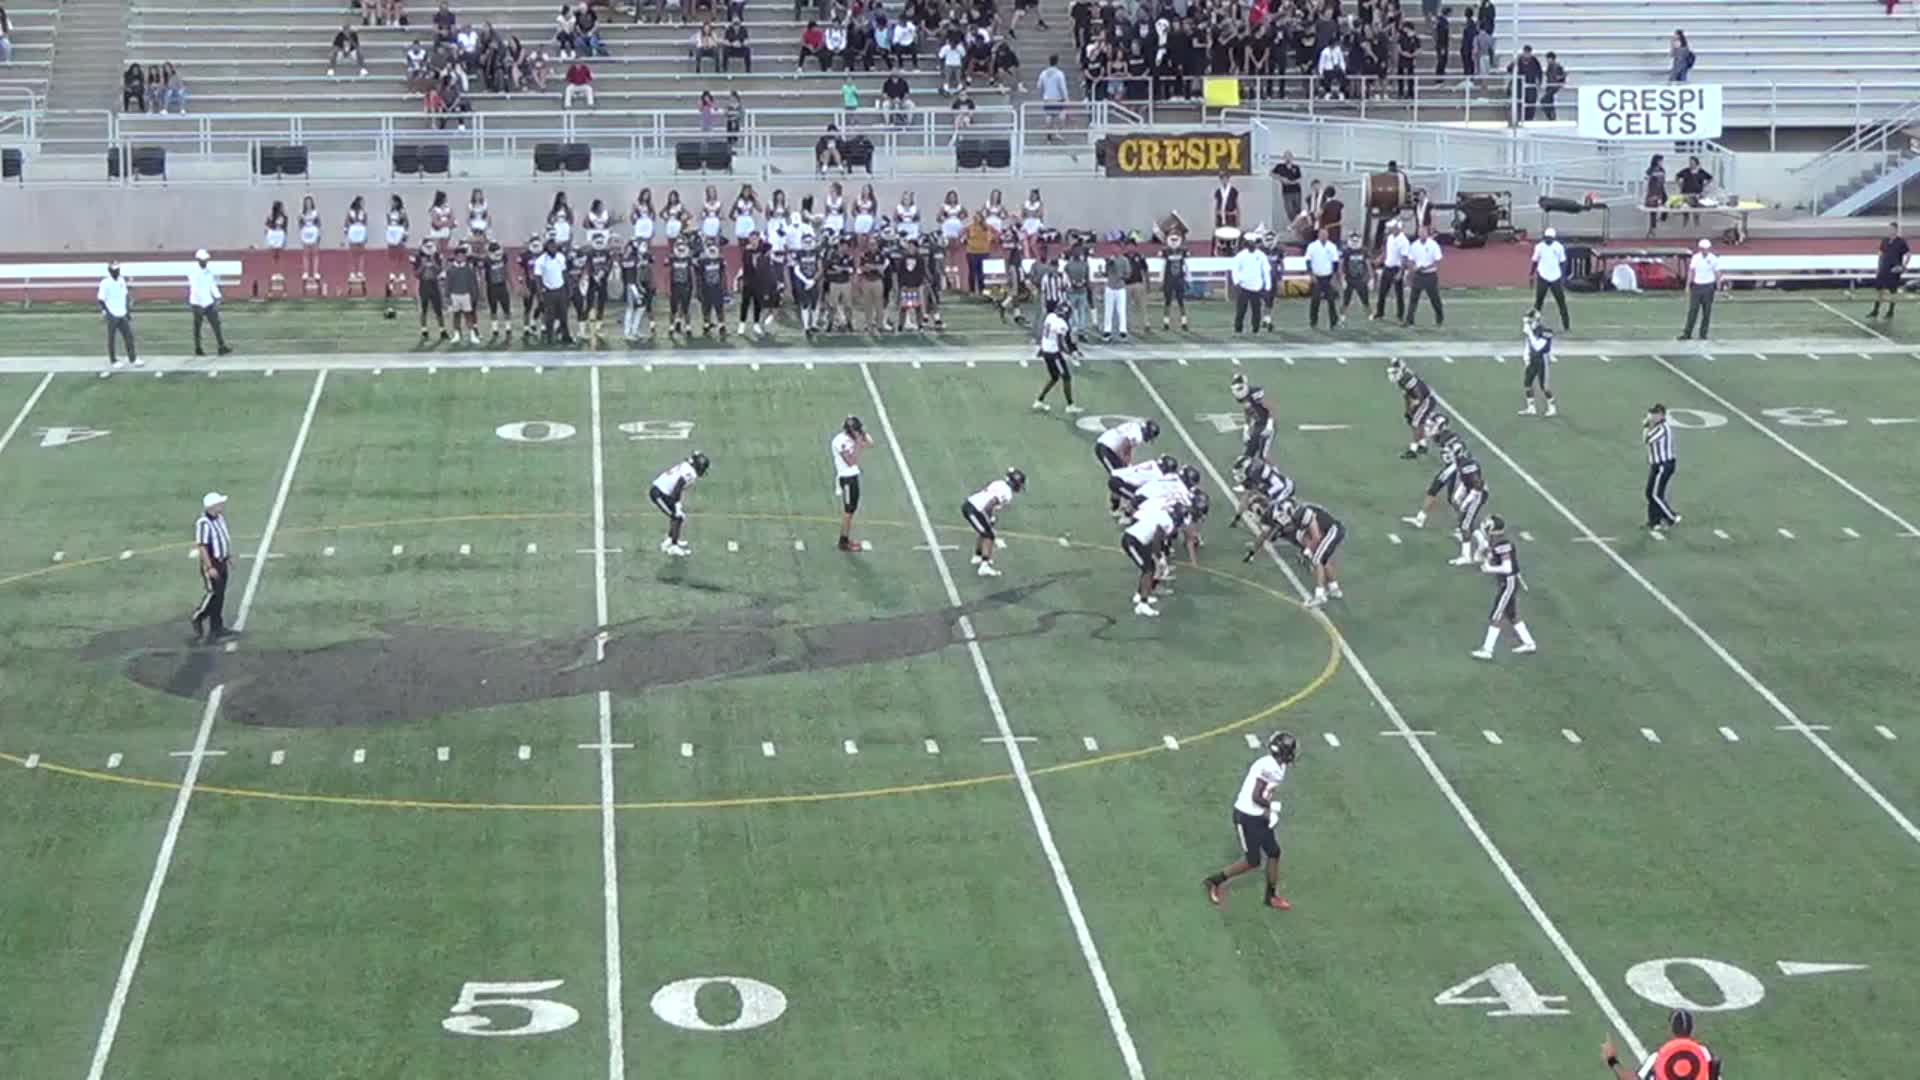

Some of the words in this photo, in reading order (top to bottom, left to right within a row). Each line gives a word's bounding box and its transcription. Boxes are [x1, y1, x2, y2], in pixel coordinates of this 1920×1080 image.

[1597, 88, 1704, 112] CRESPI
[1603, 112, 1697, 136] CELTS
[1117, 138, 1241, 172] CRESPI
